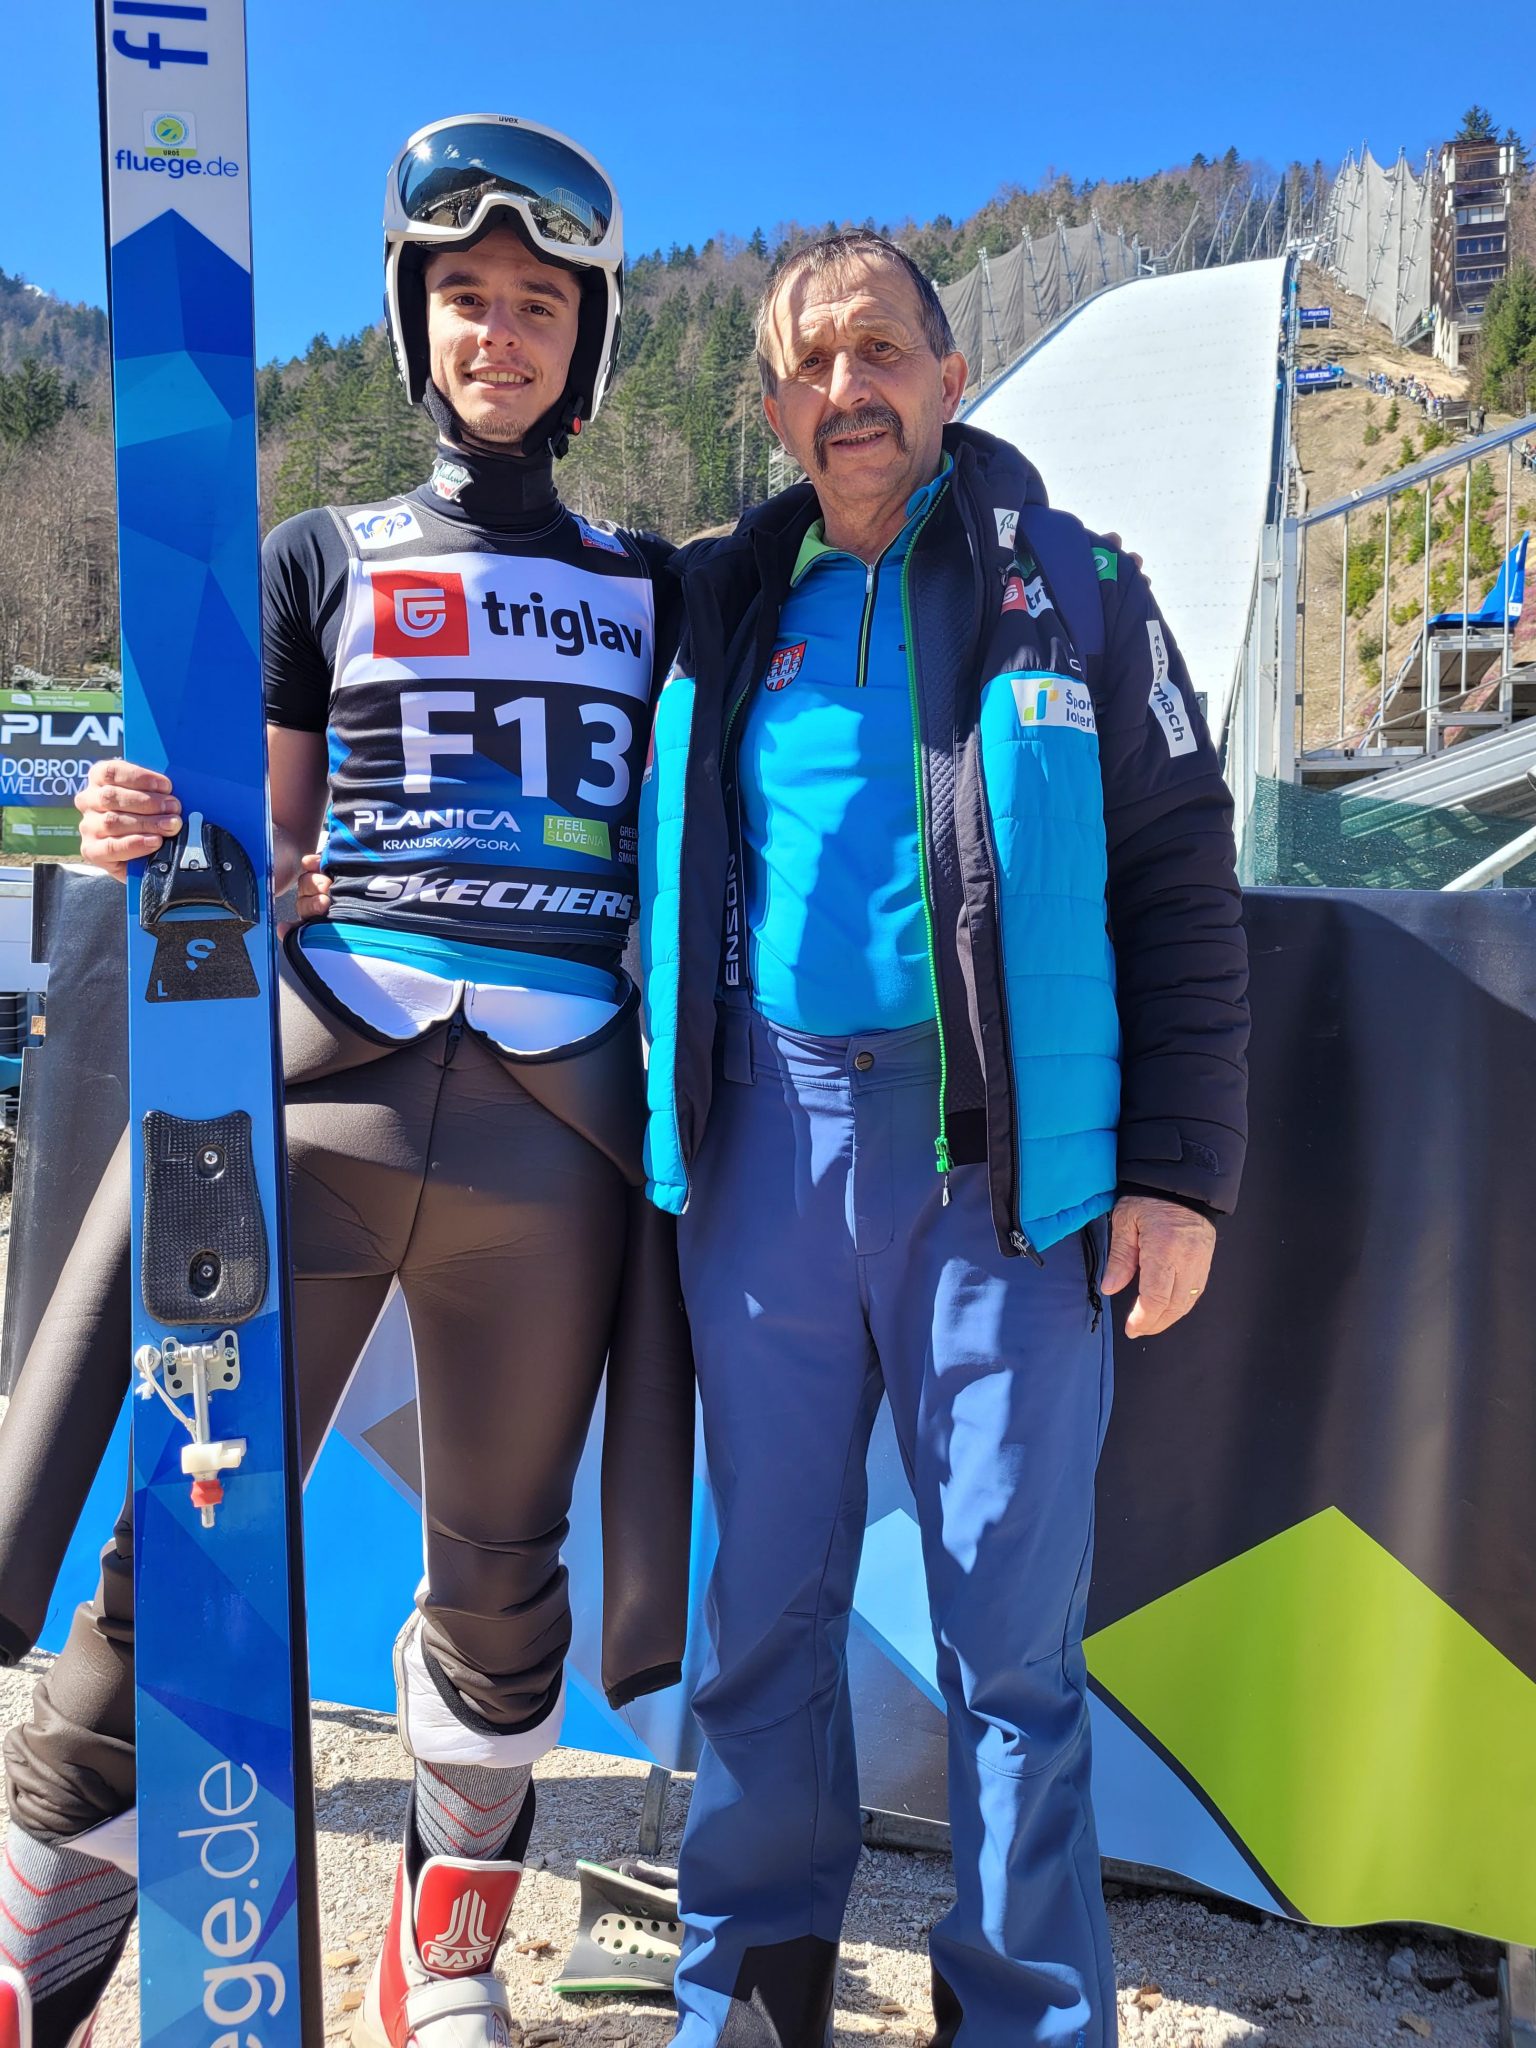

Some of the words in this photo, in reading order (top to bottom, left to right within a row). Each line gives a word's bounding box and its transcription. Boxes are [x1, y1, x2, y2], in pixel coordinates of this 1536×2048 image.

[498, 115, 519, 125] uvex
[115, 149, 239, 179] fluege.de
[162, 148, 180, 157] UROŠ
[481, 590, 642, 658] triglav
[400, 691, 634, 807] F13
[353, 809, 522, 833] PLANICA
[547, 818, 554, 829] I
[556, 819, 586, 832] FEEL
[547, 830, 604, 847] SLOVENIA
[364, 875, 634, 920] SKECHERS
[157, 980, 169, 998] L
[178, 1760, 287, 2048] ge.de
